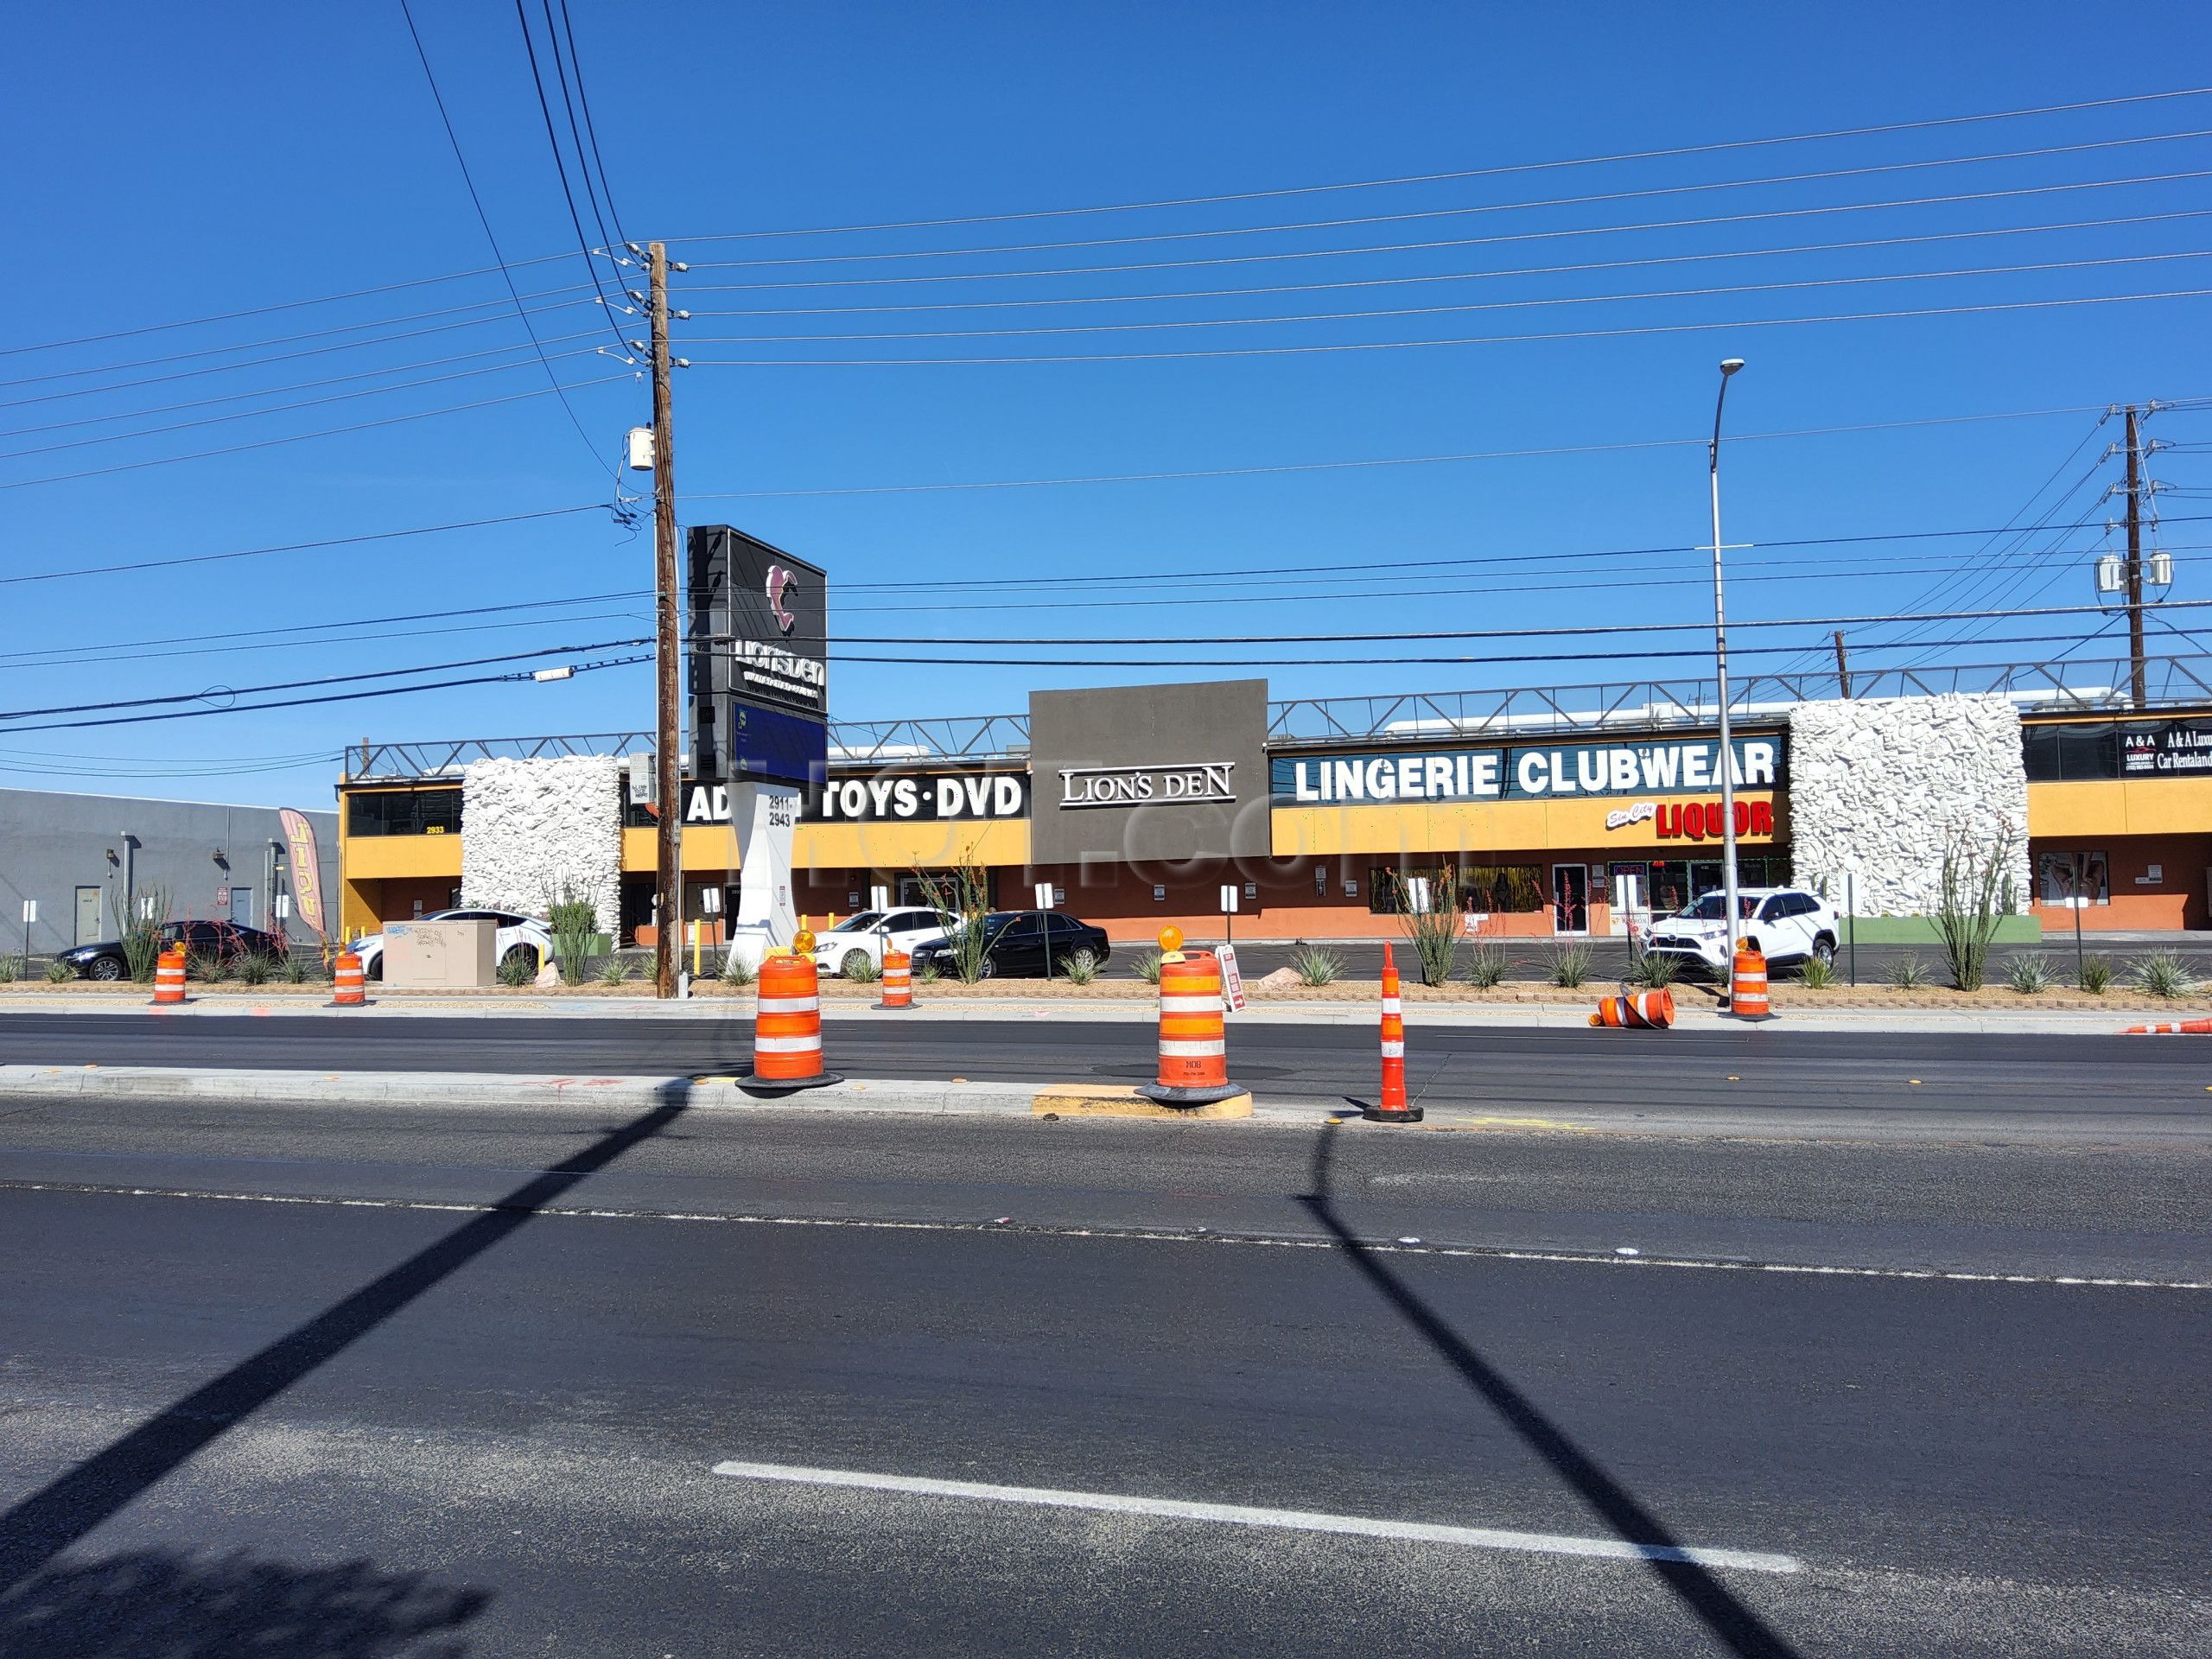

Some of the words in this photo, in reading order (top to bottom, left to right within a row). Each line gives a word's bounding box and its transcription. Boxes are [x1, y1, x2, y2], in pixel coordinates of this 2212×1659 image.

[2126, 753, 2155, 762] LUXURY
[2157, 753, 2172, 769] Car
[1295, 754, 1499, 802] LINGERIE
[1518, 742, 1776, 793] CLUBWEAR
[1061, 772, 1154, 801] LION'S
[1164, 766, 1233, 798] DEN
[823, 779, 918, 817] TOYS
[937, 777, 1022, 817] DVD
[769, 811, 791, 828] 2943
[1610, 811, 1628, 823] Sin
[1631, 803, 1655, 820] City
[1656, 800, 1772, 839] LIQUOR
[426, 825, 445, 835] 2933
[1615, 866, 1643, 875] OPEN
